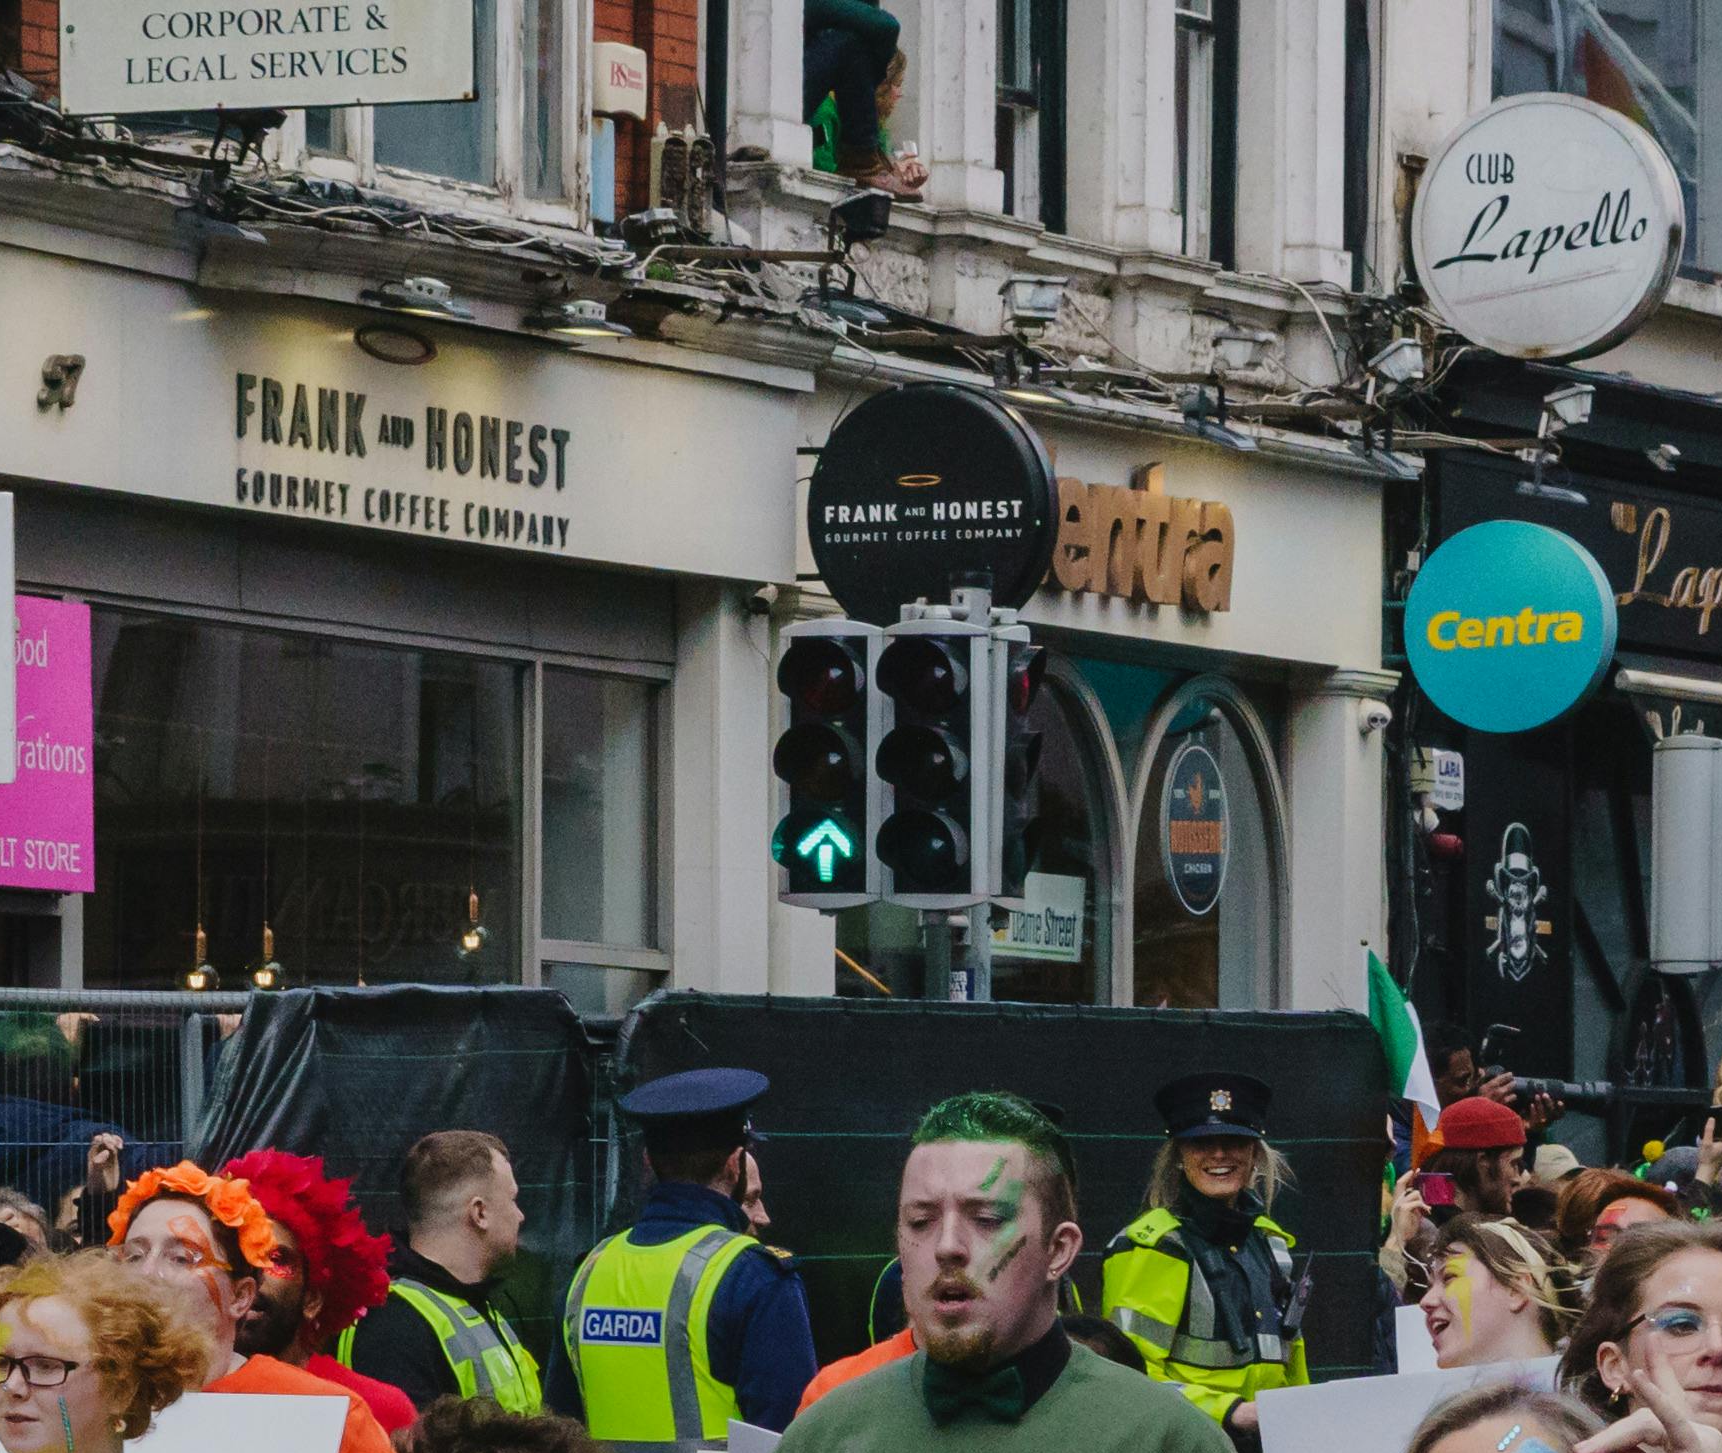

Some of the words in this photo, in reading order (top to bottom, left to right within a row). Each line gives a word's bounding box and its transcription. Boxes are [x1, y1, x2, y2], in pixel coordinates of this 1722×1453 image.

[142, 4, 350, 40] CORPORATE
[366, 3, 390, 31] &
[125, 53, 238, 85] LEGAL
[250, 46, 408, 81] SERVICES
[1466, 153, 1514, 184] CLUB
[1432, 188, 1648, 275] Lapello
[235, 372, 367, 459] FRANK
[379, 413, 414, 450] AND
[426, 406, 571, 492] HONEST
[236, 467, 350, 517] GOURMET
[364, 487, 450, 533] COFFEE
[464, 502, 570, 549] COMPANY
[825, 503, 898, 524] FRANK
[904, 506, 926, 517] AND
[932, 499, 1024, 522] HONEST
[825, 532, 888, 544] GOURMET
[896, 529, 948, 541] COFFEE
[956, 528, 1024, 541] COMPANY
[1046, 462, 1235, 613] entra
[1427, 606, 1584, 651] Centra
[16, 732, 86, 774] rations
[24, 839, 81, 874] STORE
[1044, 906, 1077, 948] Street
[585, 1312, 656, 1339] GARDA
